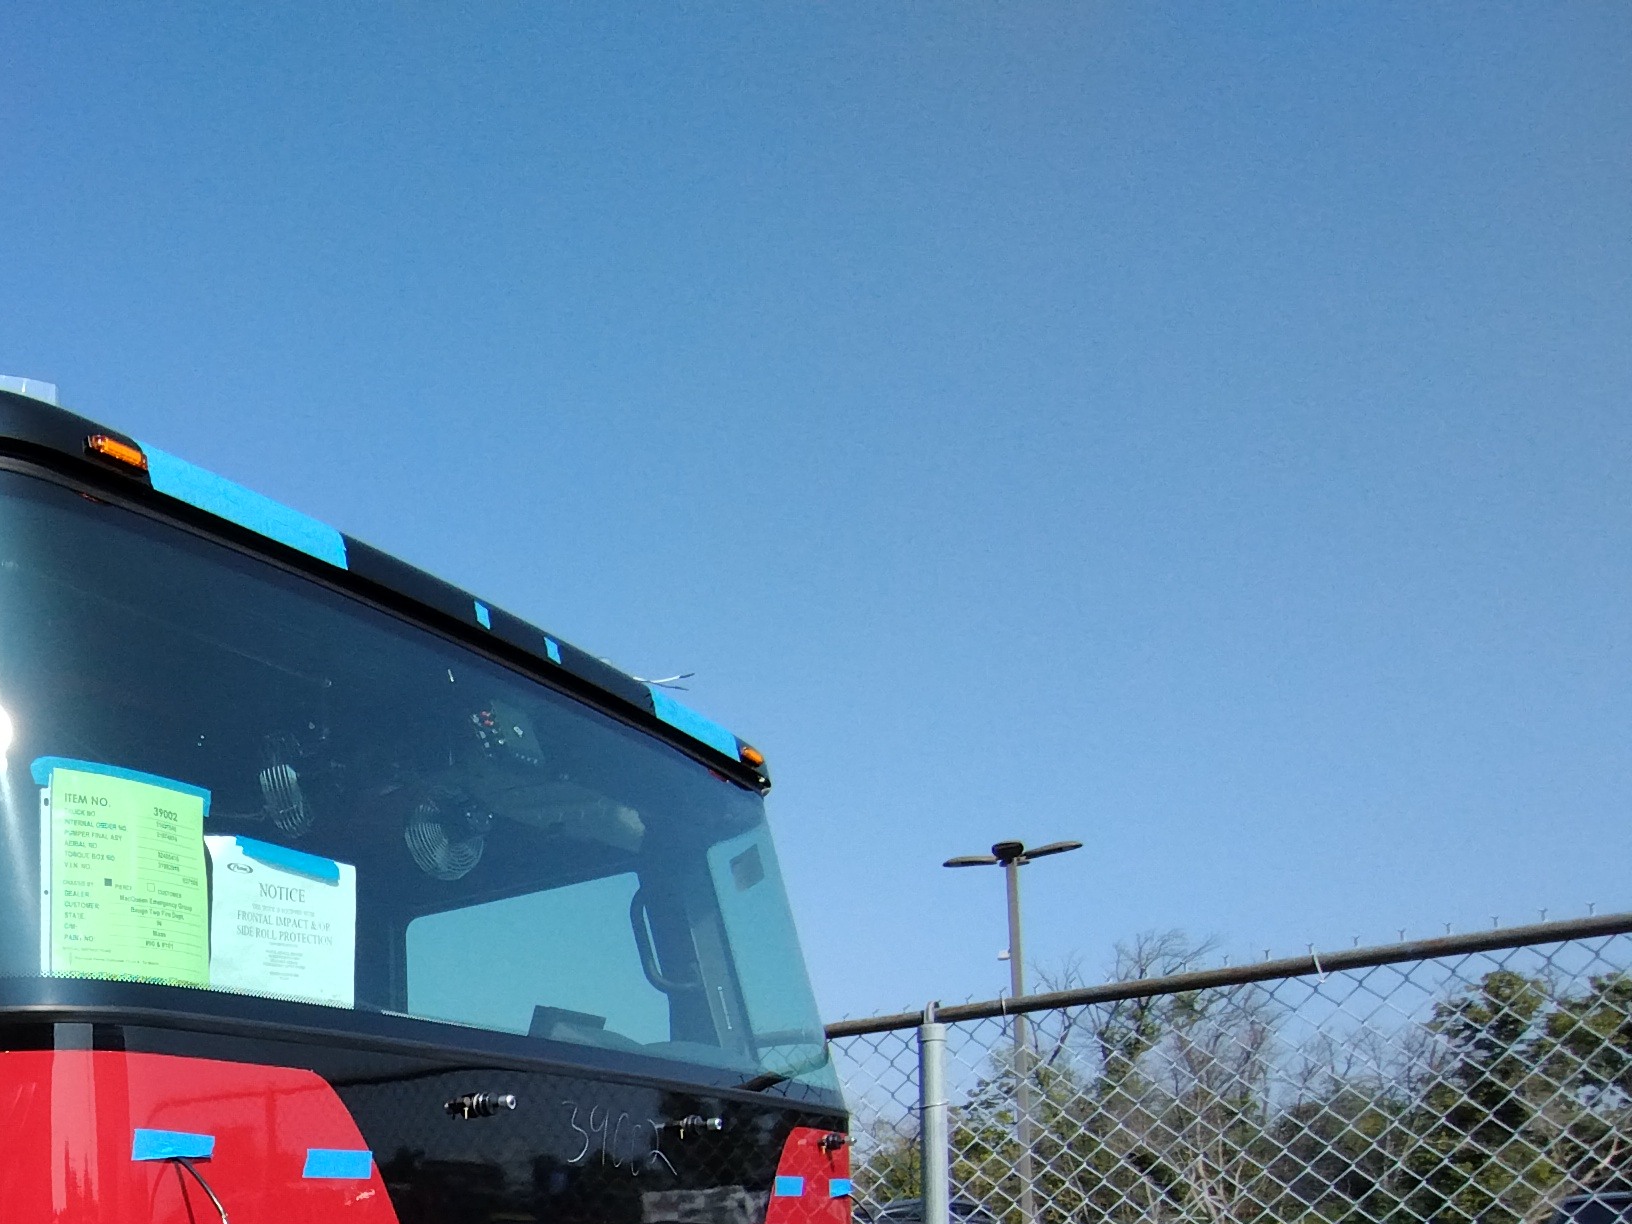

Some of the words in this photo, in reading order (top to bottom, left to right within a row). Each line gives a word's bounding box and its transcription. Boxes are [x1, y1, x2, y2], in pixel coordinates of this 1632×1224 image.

[64, 792, 88, 805] ITEM
[153, 806, 178, 822] 39002
[258, 881, 306, 903] NOTICE
[237, 909, 274, 926] FRONTAL
[275, 915, 308, 930] IMPACT
[236, 924, 255, 937] SIDE
[255, 926, 277, 941] ROLL
[278, 929, 333, 946] PROTECTION
